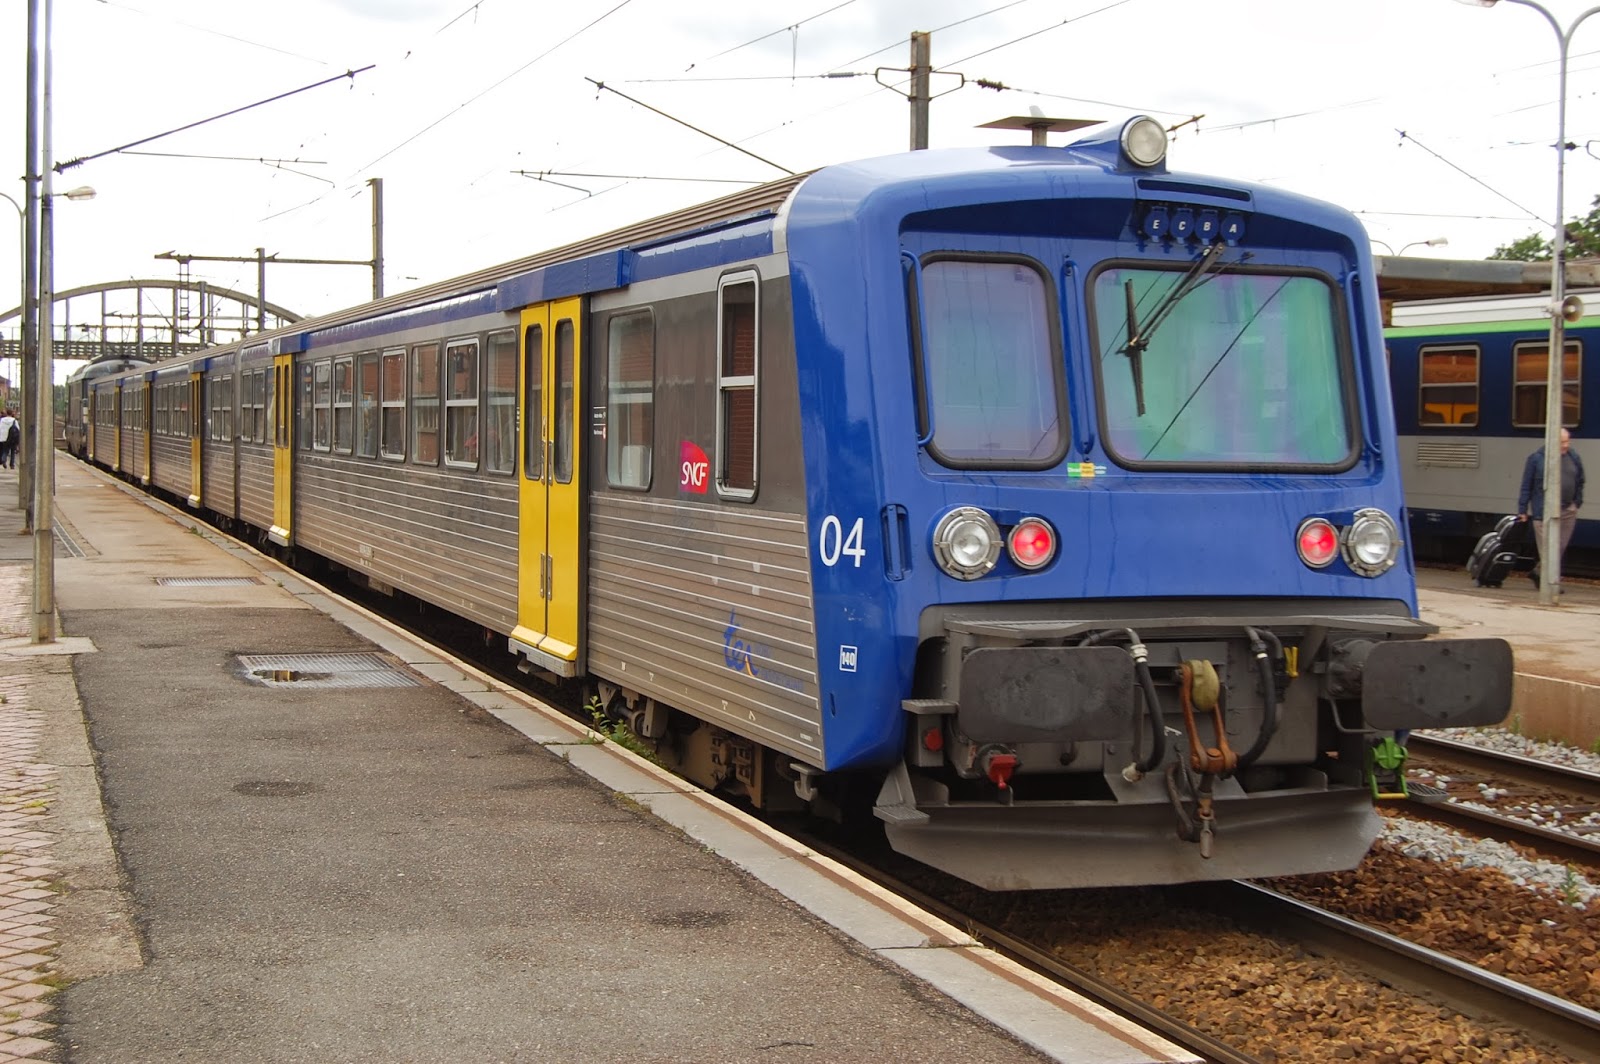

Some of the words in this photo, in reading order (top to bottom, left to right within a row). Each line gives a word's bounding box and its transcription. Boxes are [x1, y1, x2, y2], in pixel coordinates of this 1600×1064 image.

[1152, 219, 1160, 229] E
[1178, 221, 1186, 231] C
[1203, 221, 1211, 231] B
[1229, 223, 1237, 233] A
[681, 461, 708, 487] SNCF
[819, 514, 866, 568] 04
